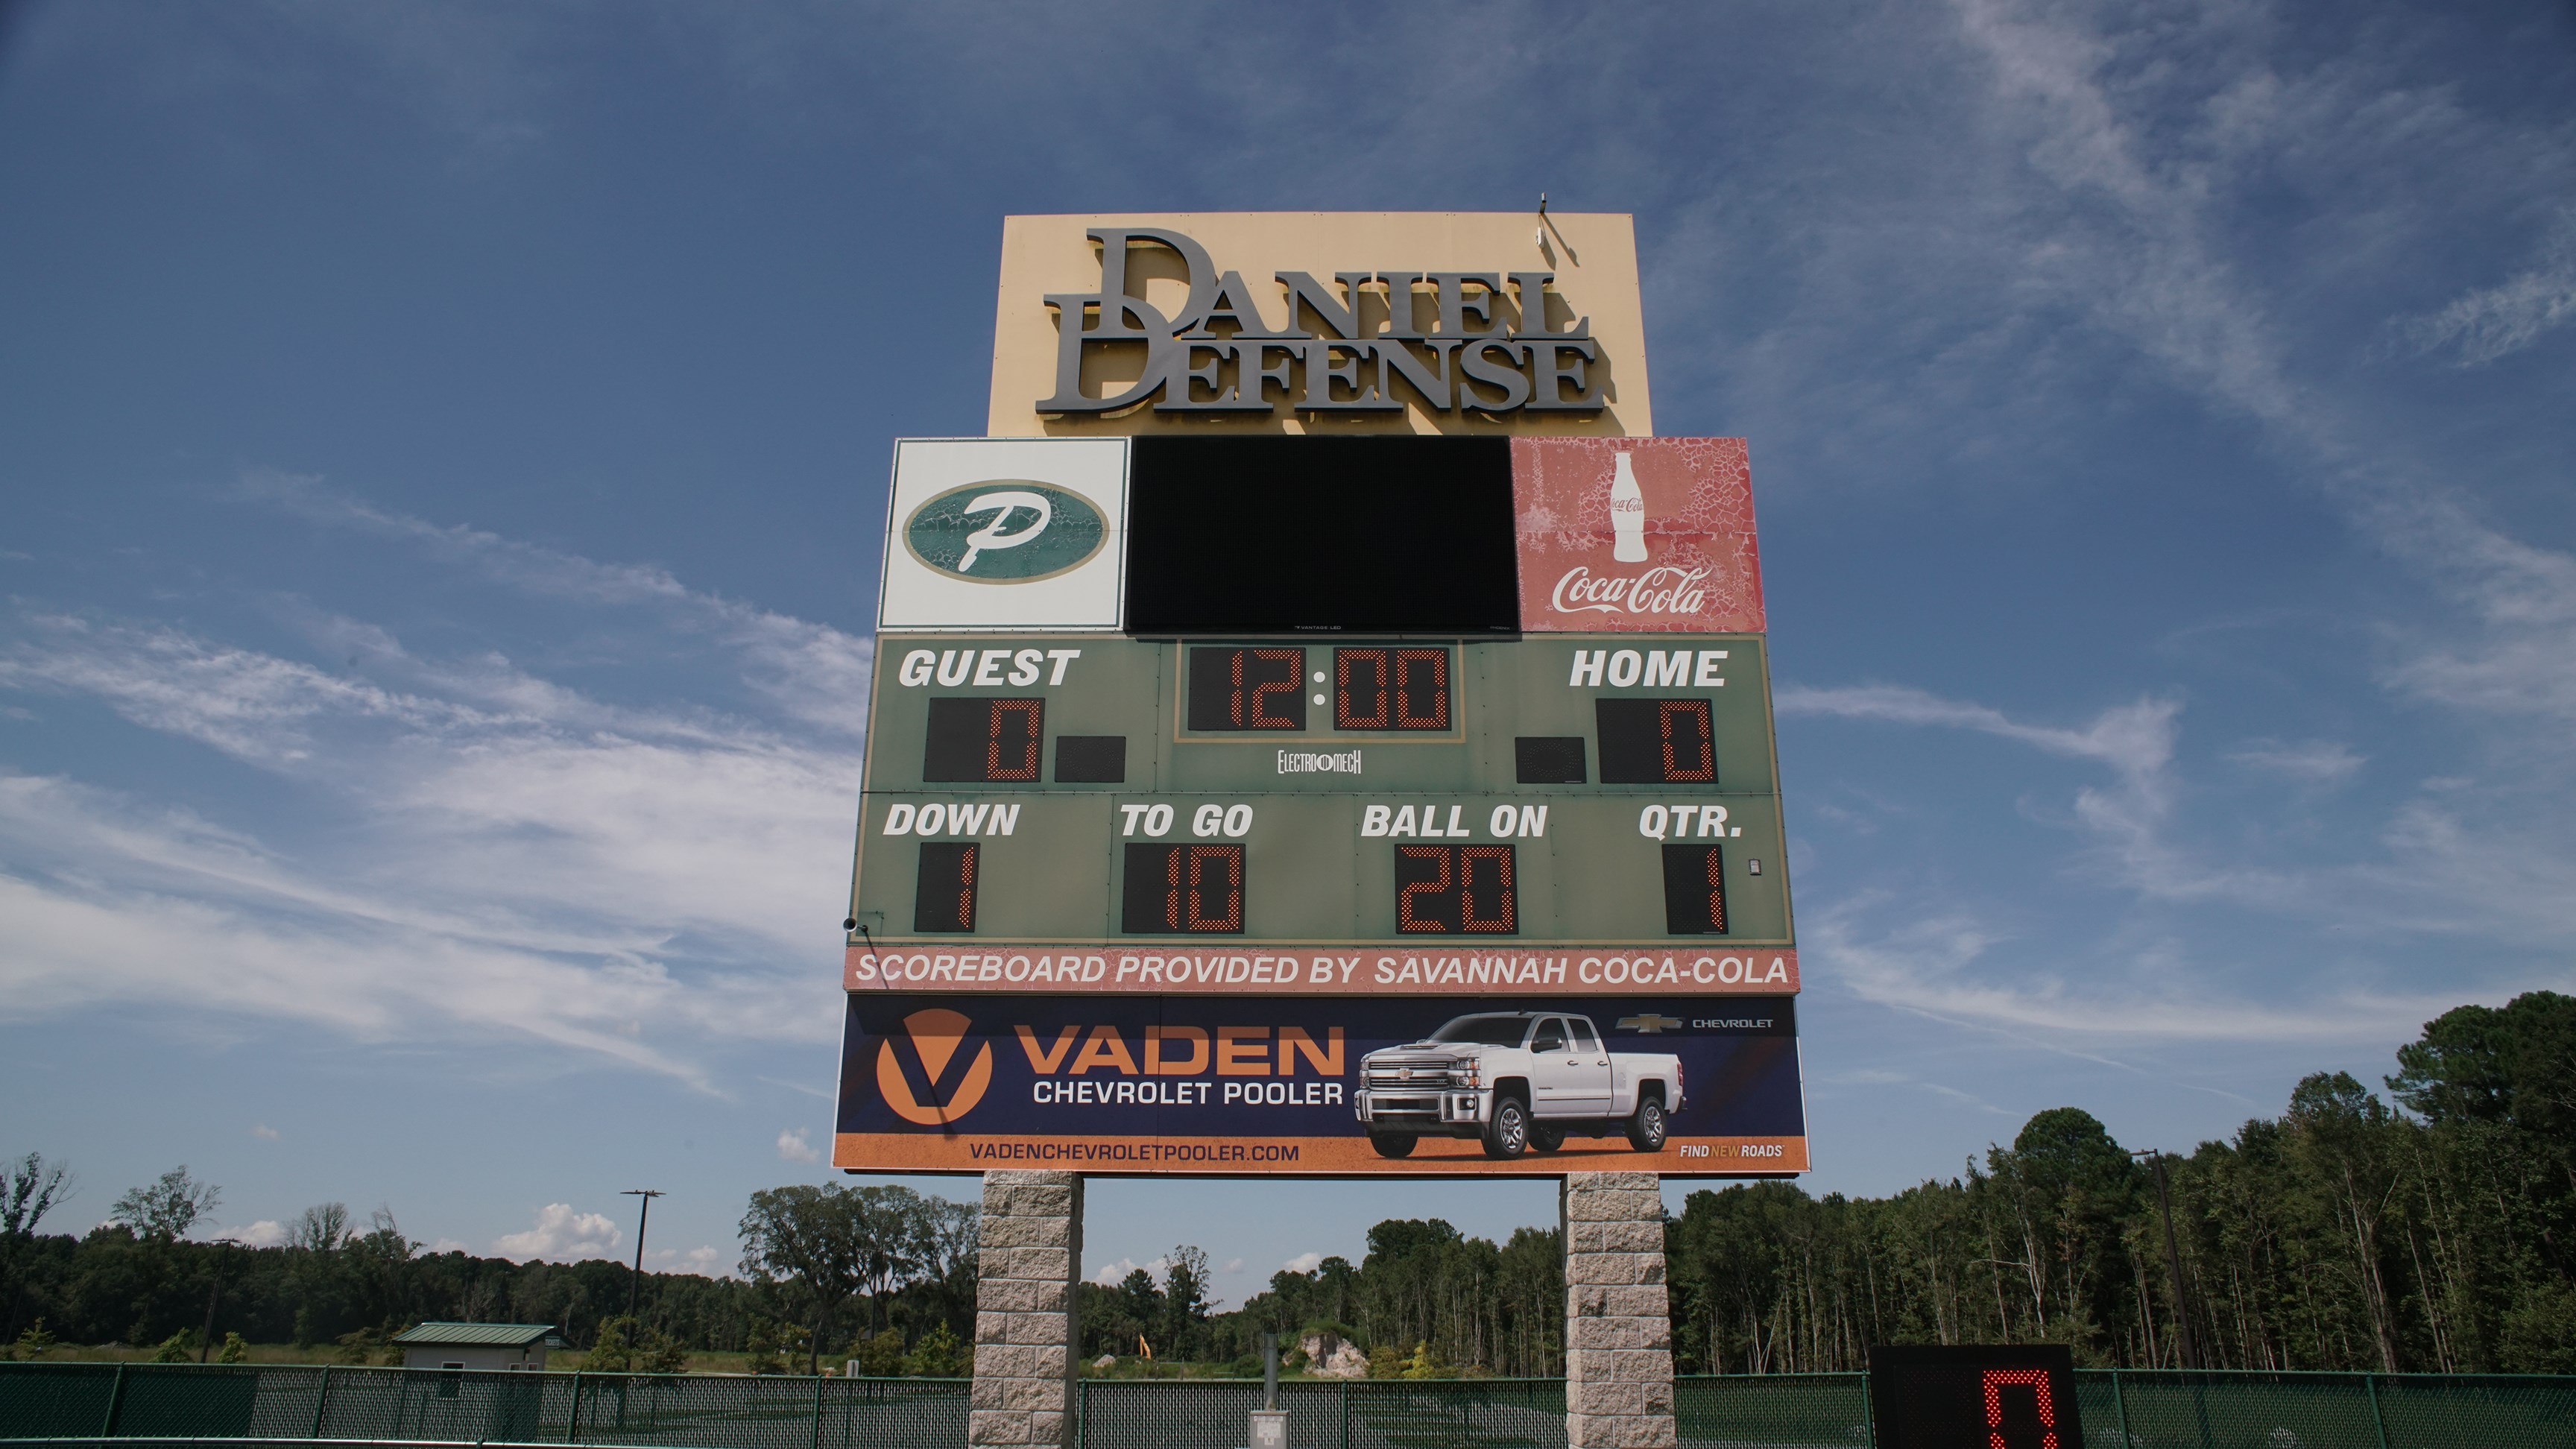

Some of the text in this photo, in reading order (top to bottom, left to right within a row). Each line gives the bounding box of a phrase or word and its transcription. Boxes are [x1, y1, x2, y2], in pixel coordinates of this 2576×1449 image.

[1086, 227, 1589, 338] DANIEL
[1035, 293, 1604, 414] DEFENSE
[958, 491, 1052, 572] P
[1552, 566, 1713, 613] Coca-Cola
[899, 649, 1081, 687] GUEST
[1569, 650, 1729, 687] HOME
[988, 700, 1040, 780] 0
[1660, 701, 1714, 780] 0
[883, 804, 1021, 836] DOWN
[1120, 804, 1253, 837] TO GO
[1360, 804, 1548, 838] BALL ON
[1639, 804, 1742, 842] QTR.
[959, 847, 975, 929] 1
[1167, 846, 1240, 930] 10
[1401, 847, 1514, 931] 20
[1706, 847, 1723, 930] 1
[856, 954, 1789, 984] SCOREBOARD PROVIDED BY SAVANNAH COCA-COLA
[1692, 1019, 1774, 1028] CHEVROLET
[1014, 1025, 1345, 1076] VADEN
[1033, 1081, 1343, 1105] CHEVROLET POOLER
[970, 1143, 1299, 1161] VADENCHEVROLETPOOLER.COM
[1679, 1145, 1710, 1158] FIND
[1711, 1145, 1740, 1157] NEW
